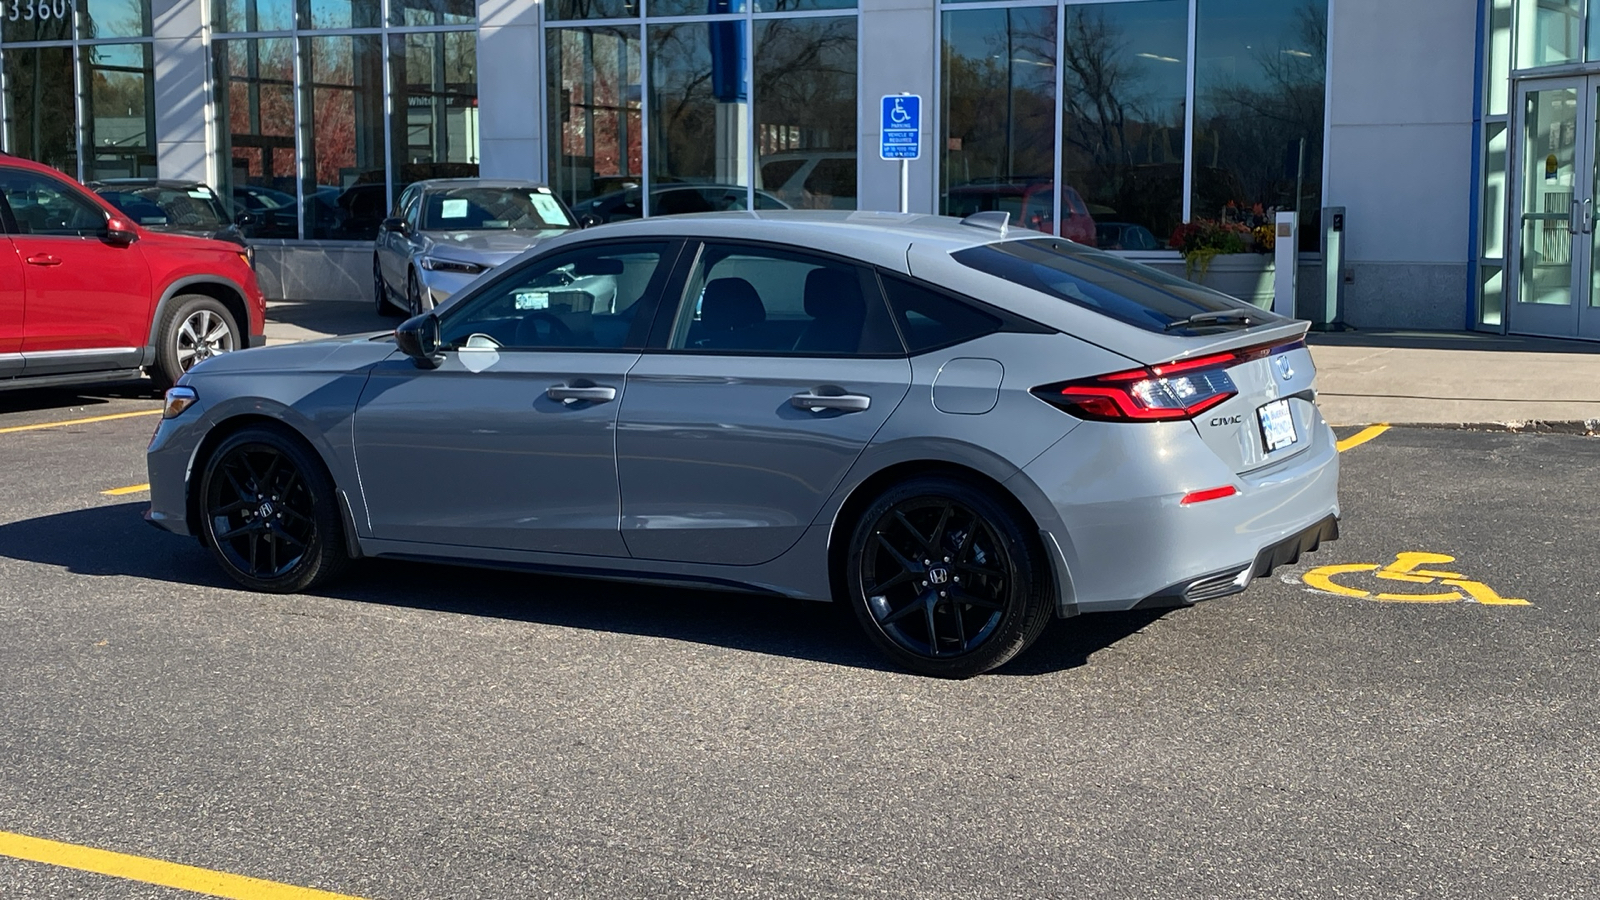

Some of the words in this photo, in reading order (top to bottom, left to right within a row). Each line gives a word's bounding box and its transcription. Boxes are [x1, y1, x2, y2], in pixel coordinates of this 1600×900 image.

[9, 0, 65, 21] 3360
[1210, 415, 1241, 427] CIVIC
[1272, 420, 1292, 435] HONDA
